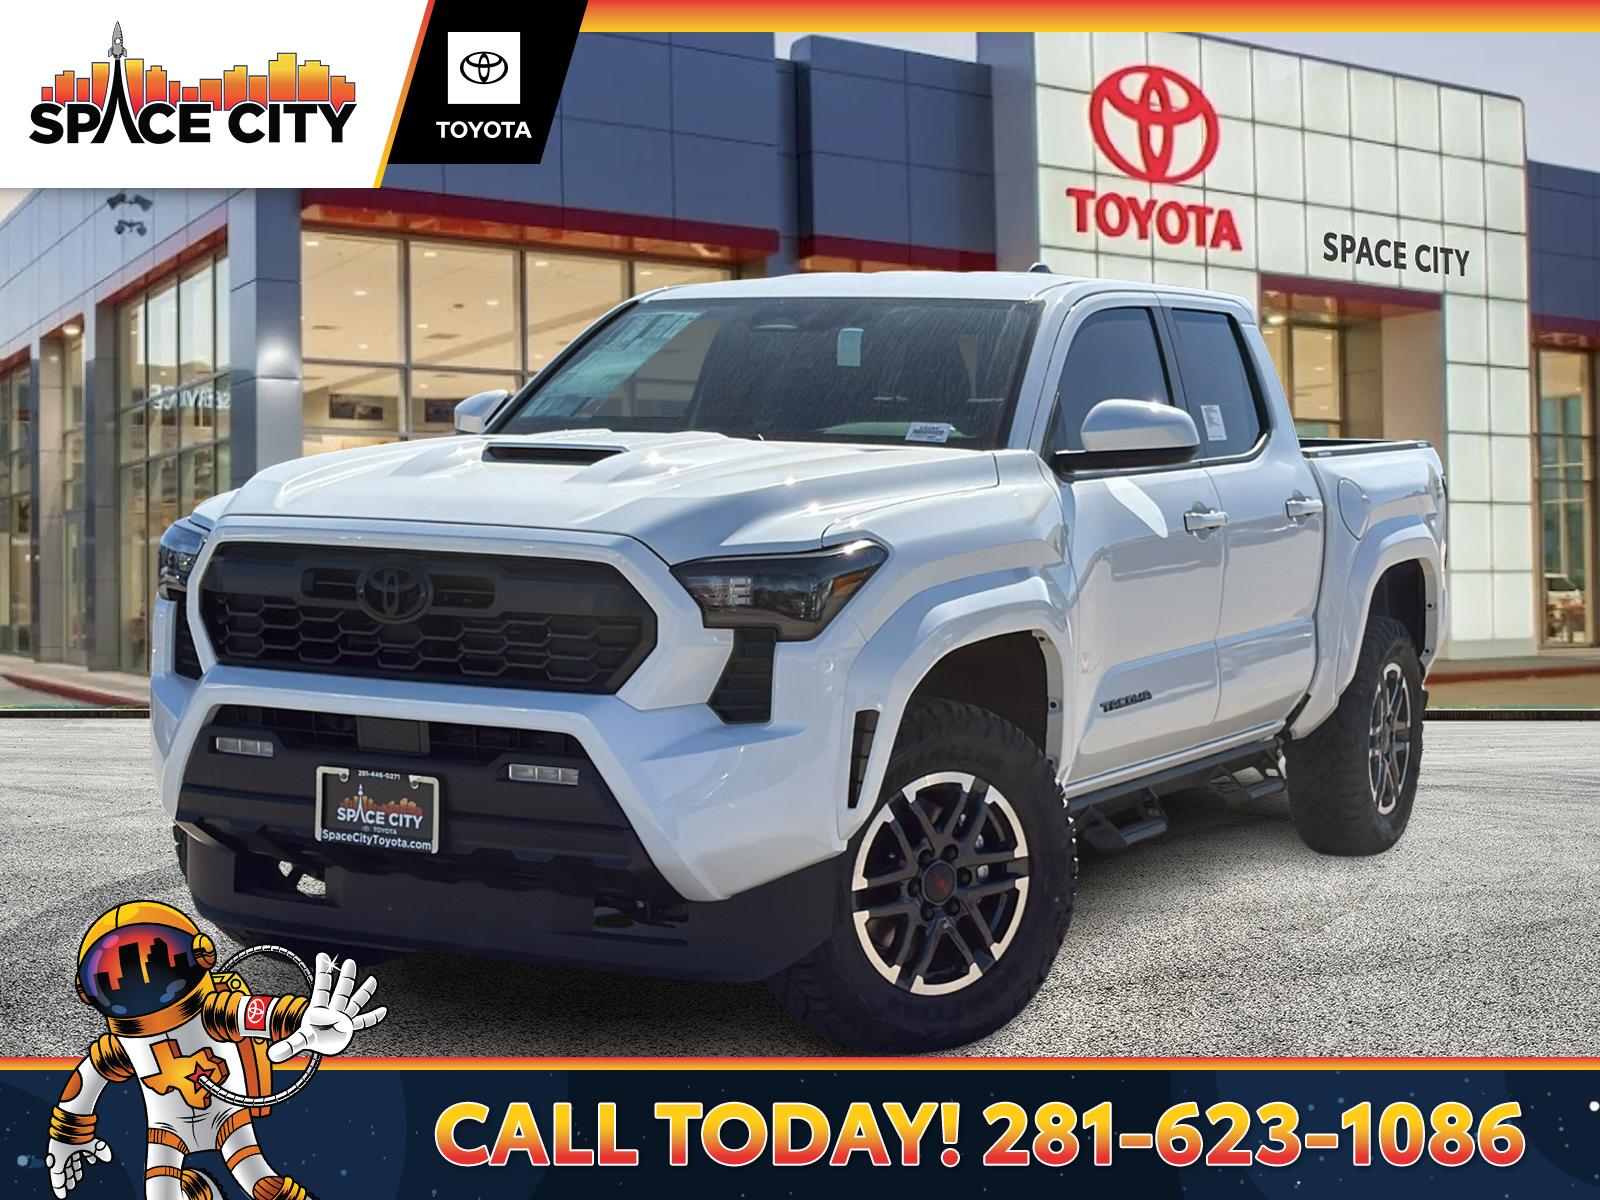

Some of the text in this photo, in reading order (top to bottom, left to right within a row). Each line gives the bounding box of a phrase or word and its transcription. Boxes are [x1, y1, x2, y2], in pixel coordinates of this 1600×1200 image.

[1066, 187, 1243, 251] TOYOTA
[1323, 232, 1471, 277] SPACE CITY
[337, 797, 423, 829] SPACE CITY
[322, 829, 432, 851] SpaceCityToyota.com
[373, 826, 398, 835] TOYOTA
